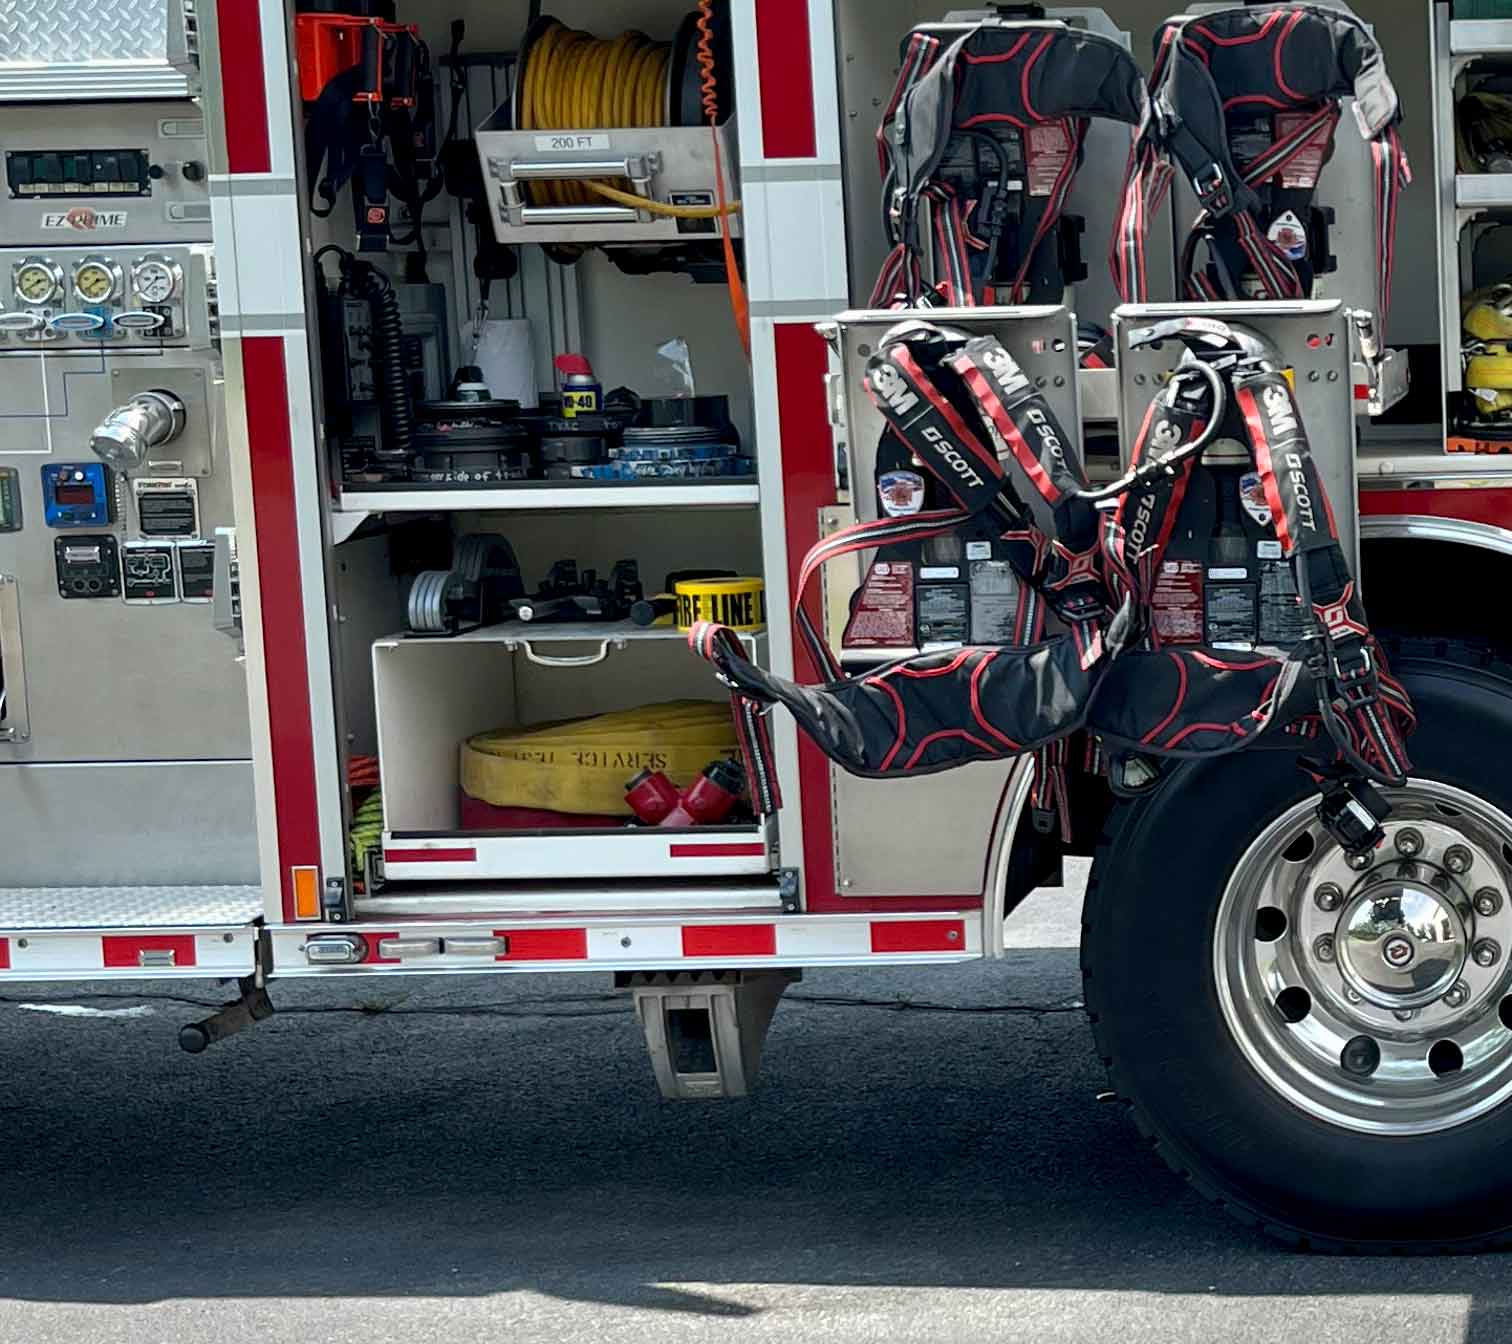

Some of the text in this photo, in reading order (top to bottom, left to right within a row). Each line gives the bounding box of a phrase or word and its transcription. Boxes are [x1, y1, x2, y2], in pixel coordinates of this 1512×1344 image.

[551, 136, 593, 149] 200 FT
[872, 364, 920, 416] 3M
[983, 348, 1030, 395] 3M
[1263, 385, 1298, 436] 3M
[936, 440, 984, 488] SCOTT
[1288, 469, 1316, 532] SCOTT
[1127, 506, 1150, 565] SCOTT
[711, 592, 754, 625] LINE
[571, 752, 668, 768] SERVICE
